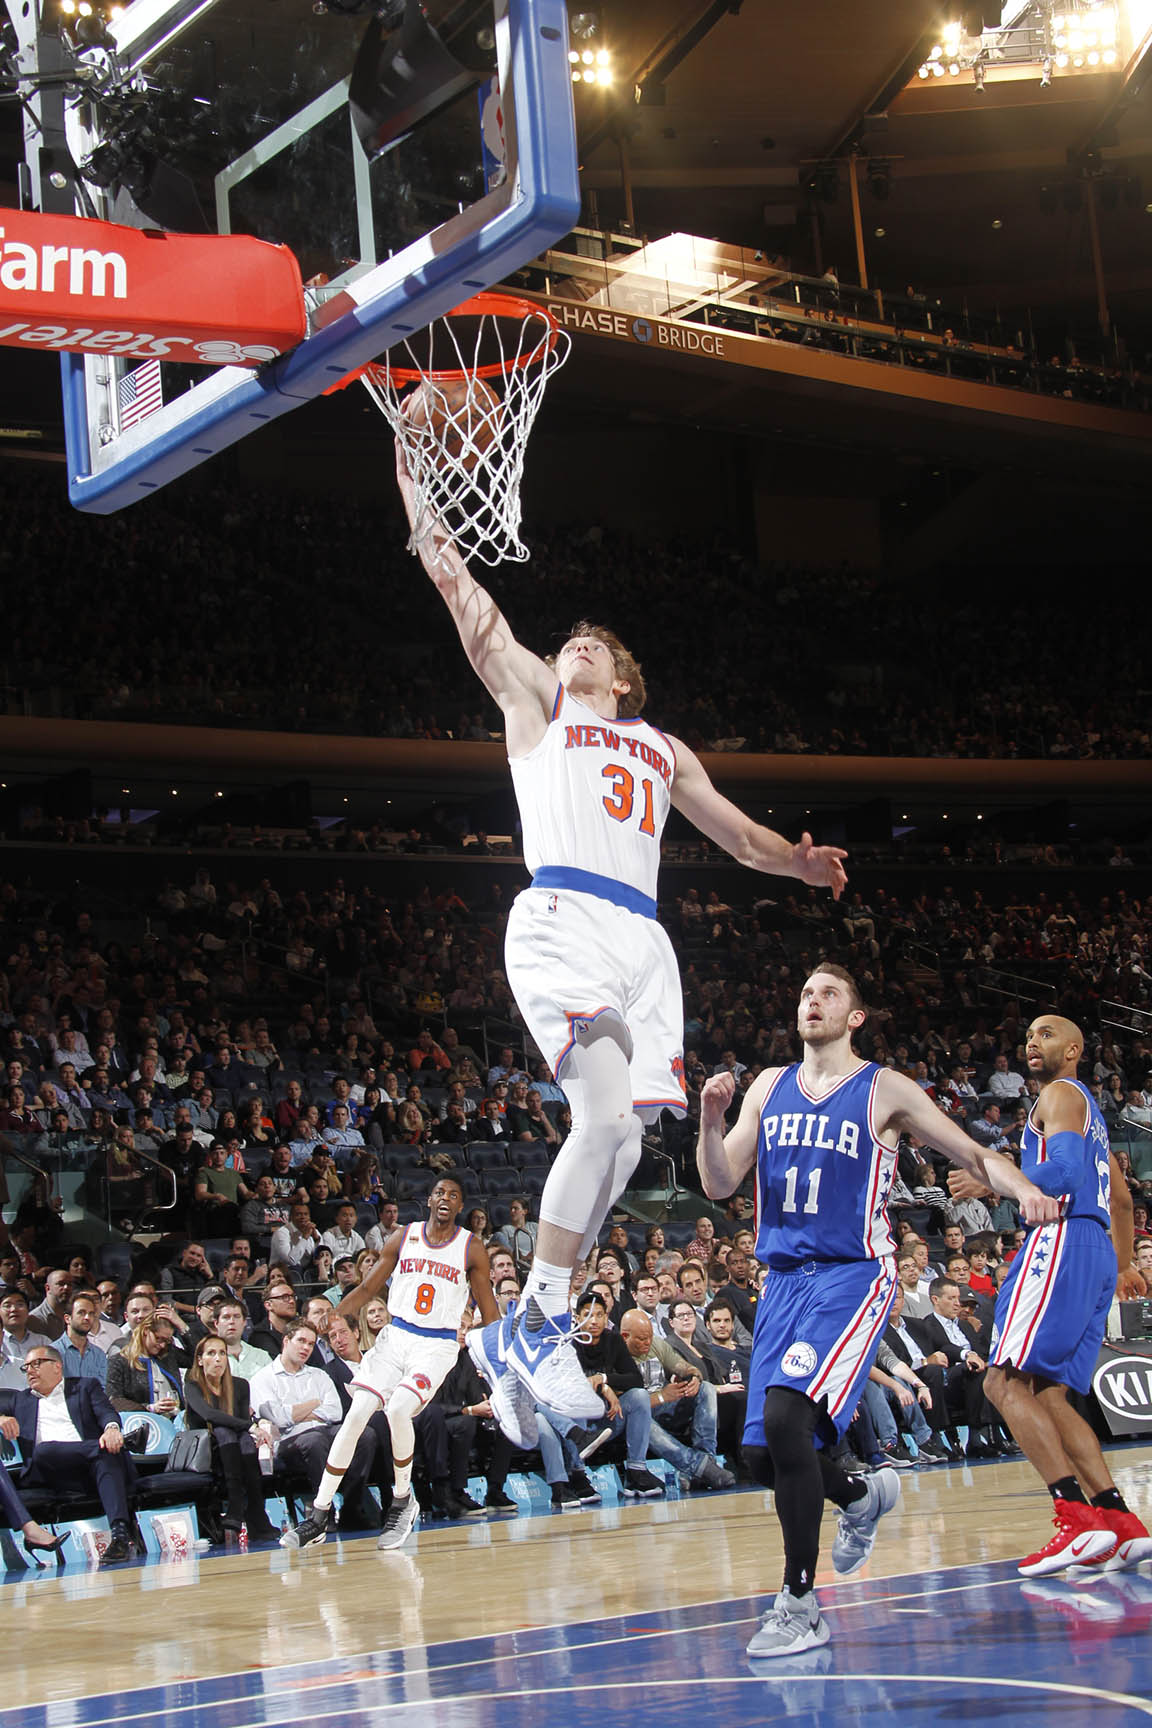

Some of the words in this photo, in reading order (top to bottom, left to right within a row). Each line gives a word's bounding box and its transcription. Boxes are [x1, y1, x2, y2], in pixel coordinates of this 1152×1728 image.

[0, 226, 127, 298] arm
[547, 304, 630, 337] CHASE
[657, 325, 725, 356] BRIDGE
[565, 725, 621, 751] NEW
[622, 737, 672, 791] YORK
[601, 763, 656, 838] 31
[763, 1113, 860, 1159] PHILA
[782, 1166, 822, 1214] 11
[400, 1258, 427, 1274] NEW
[425, 1259, 460, 1285] YORK
[414, 1283, 436, 1315] 8
[1104, 1370, 1152, 1407] KI
